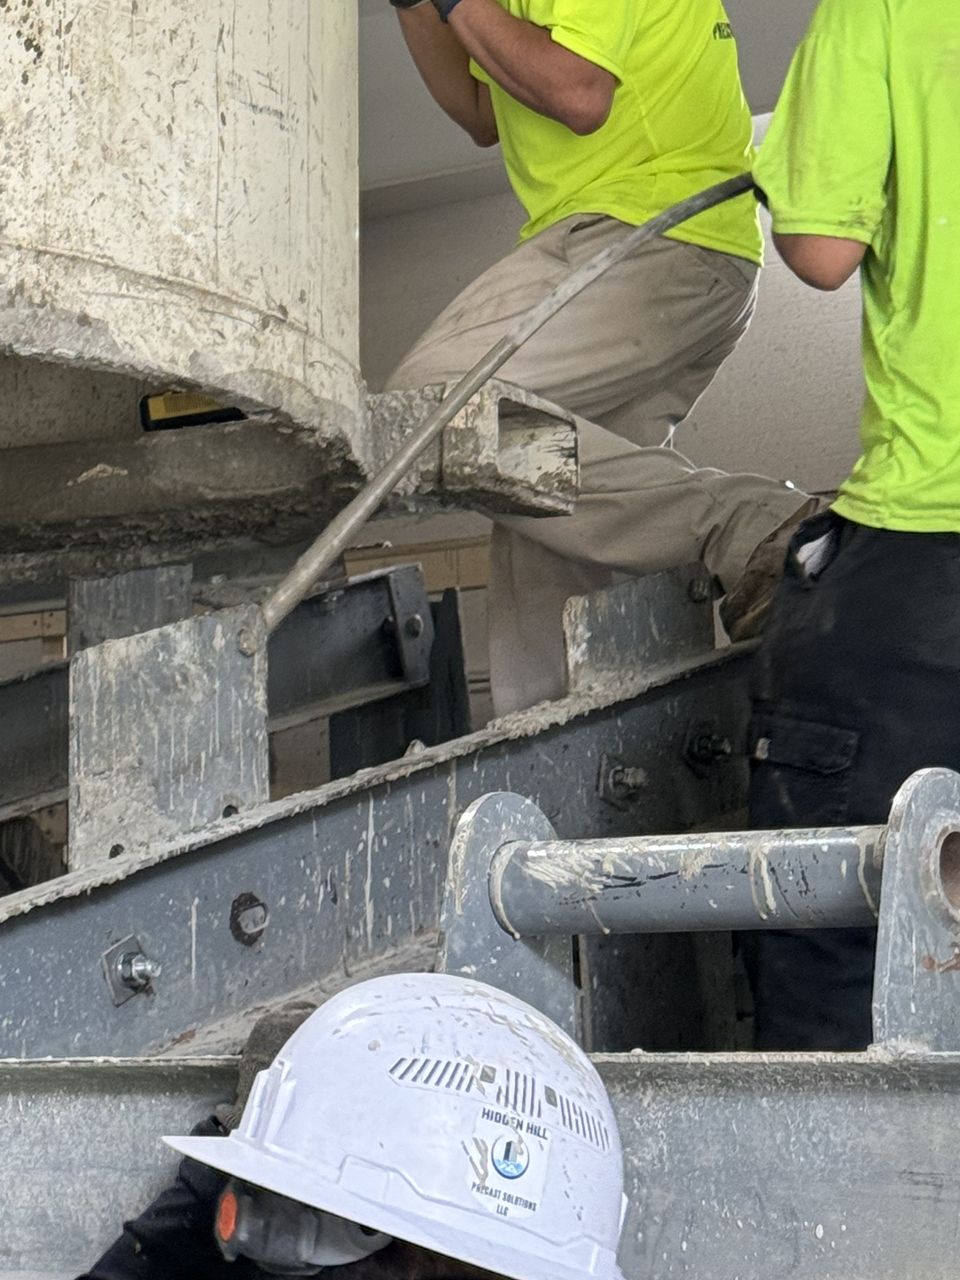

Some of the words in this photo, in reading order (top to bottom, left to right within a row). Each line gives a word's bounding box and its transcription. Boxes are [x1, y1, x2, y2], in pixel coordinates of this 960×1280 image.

[526, 1122, 548, 1140] HILL
[471, 1182, 502, 1200] PRECAST
[502, 1192, 537, 1212] SOLUTIONS
[496, 1204, 509, 1216] LLC
